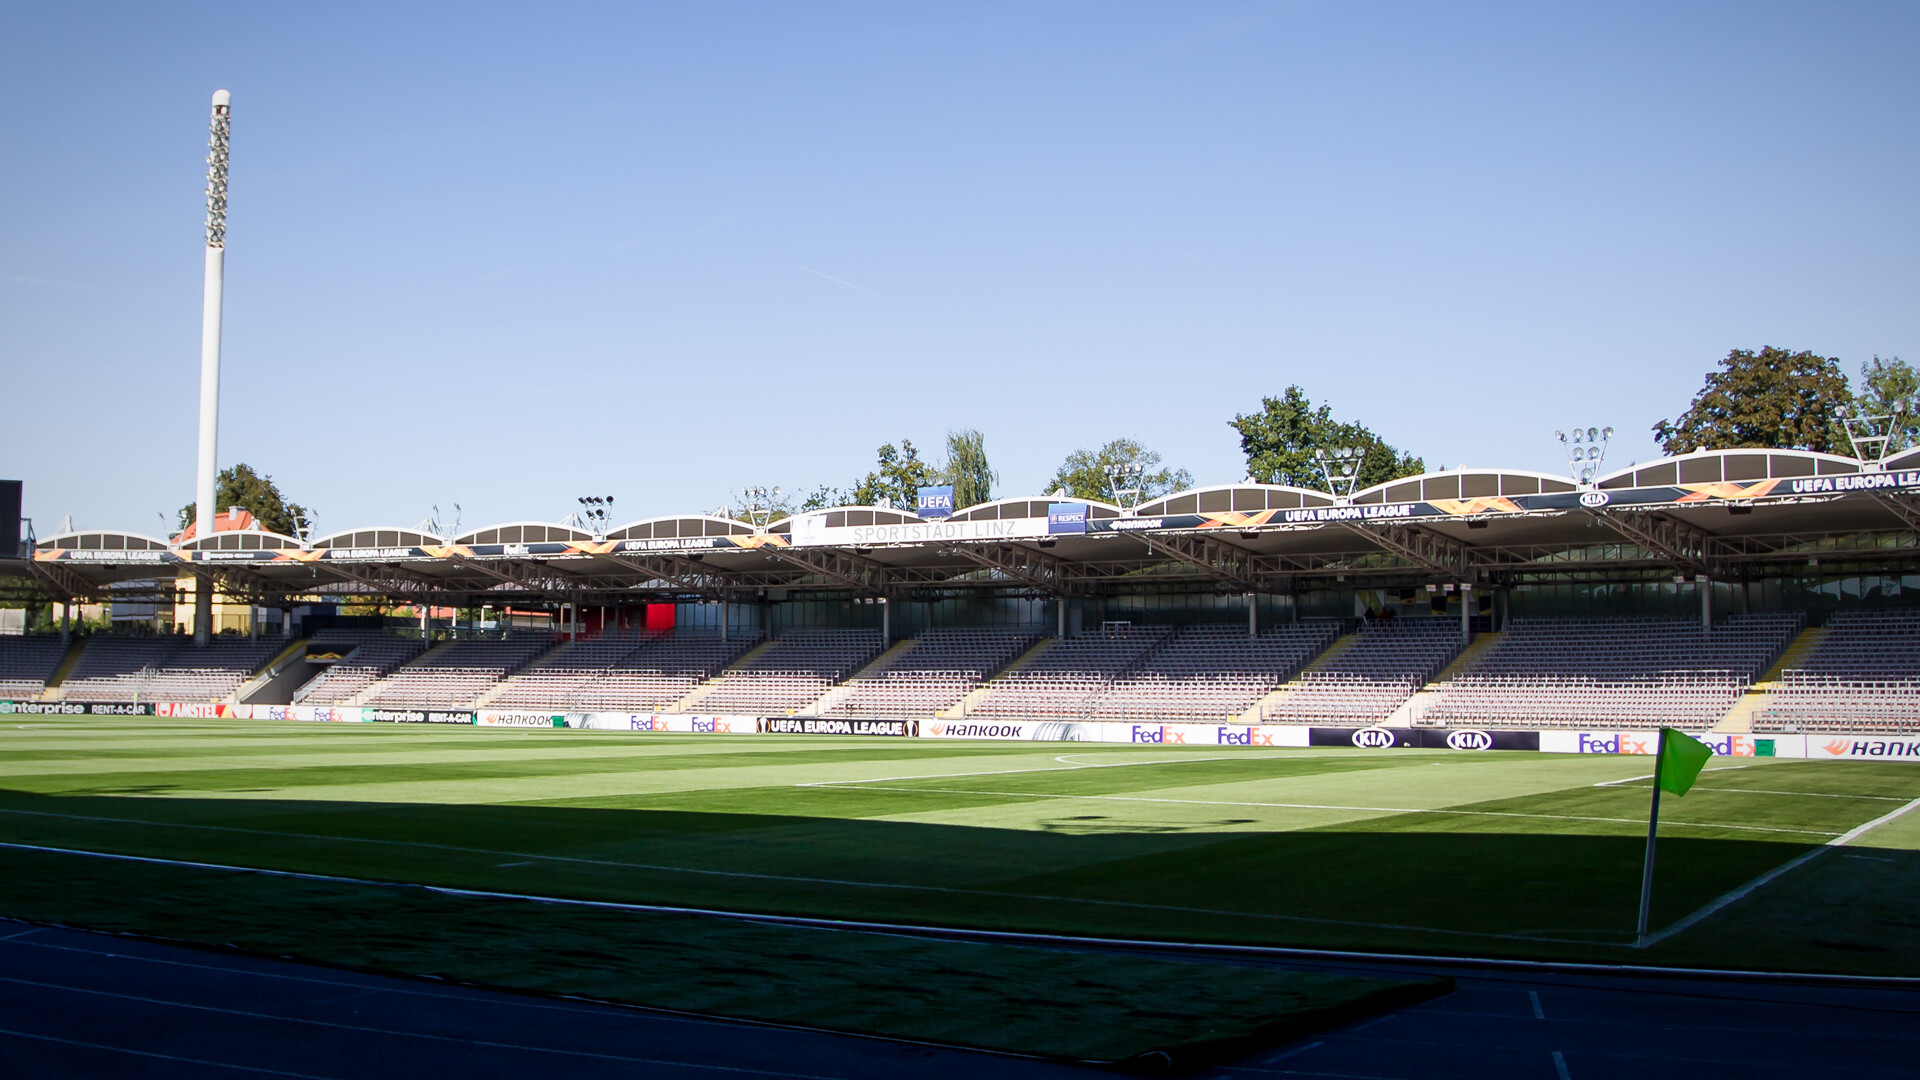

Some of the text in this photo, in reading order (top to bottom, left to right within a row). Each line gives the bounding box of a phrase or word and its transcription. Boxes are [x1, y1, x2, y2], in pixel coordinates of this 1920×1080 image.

[1792, 471, 1920, 493] UEFA EUROPA LE
[919, 496, 950, 508] UEFA
[1286, 510, 1314, 521] UEFA
[1317, 507, 1361, 520] EUROPA
[854, 520, 1016, 542] SPORTSTADT LINZ
[625, 541, 647, 551] UEFA
[648, 540, 680, 550] EUROPA
[70, 551, 93, 560] UEFA
[93, 551, 127, 560] EUROPA
[331, 550, 351, 559] UEFA
[351, 549, 379, 558] EUROPA
[0, 702, 146, 715] enterprise RENT-A-CAR
[172, 703, 219, 718] AMSTEL
[270, 707, 298, 721] FedEx
[314, 708, 343, 722] FedEx
[363, 710, 472, 723] enterprise RENT-A-CAR
[631, 716, 670, 731] FedEx
[692, 717, 732, 732] FedEx
[770, 720, 903, 736] UEFA EUROPA LEAGUE
[1132, 725, 1186, 744] FedEx
[1217, 726, 1275, 746] FedEx
[1579, 733, 1648, 755] FedEx
